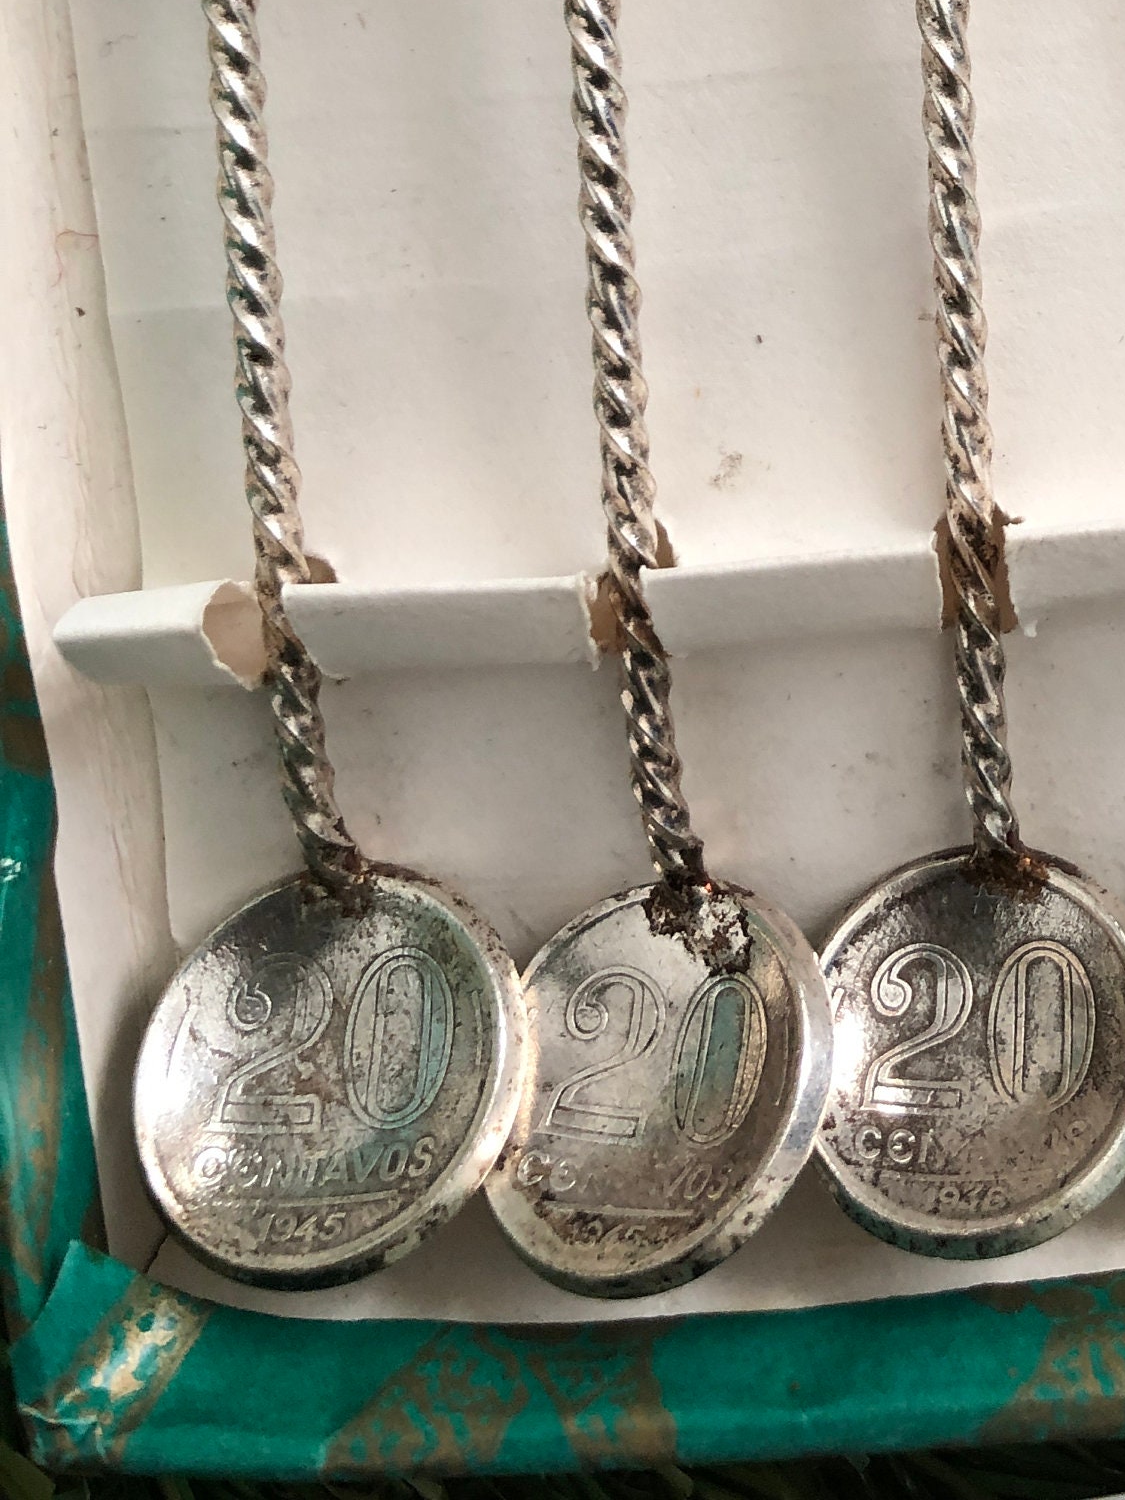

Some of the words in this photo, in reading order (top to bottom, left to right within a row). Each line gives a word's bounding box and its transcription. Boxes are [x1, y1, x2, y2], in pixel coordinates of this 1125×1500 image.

[205, 946, 455, 1135] 20
[533, 964, 768, 1150] 20
[860, 939, 1096, 1114] 20
[194, 1136, 437, 1188] CENTAVOS
[260, 1211, 346, 1245] 1945
